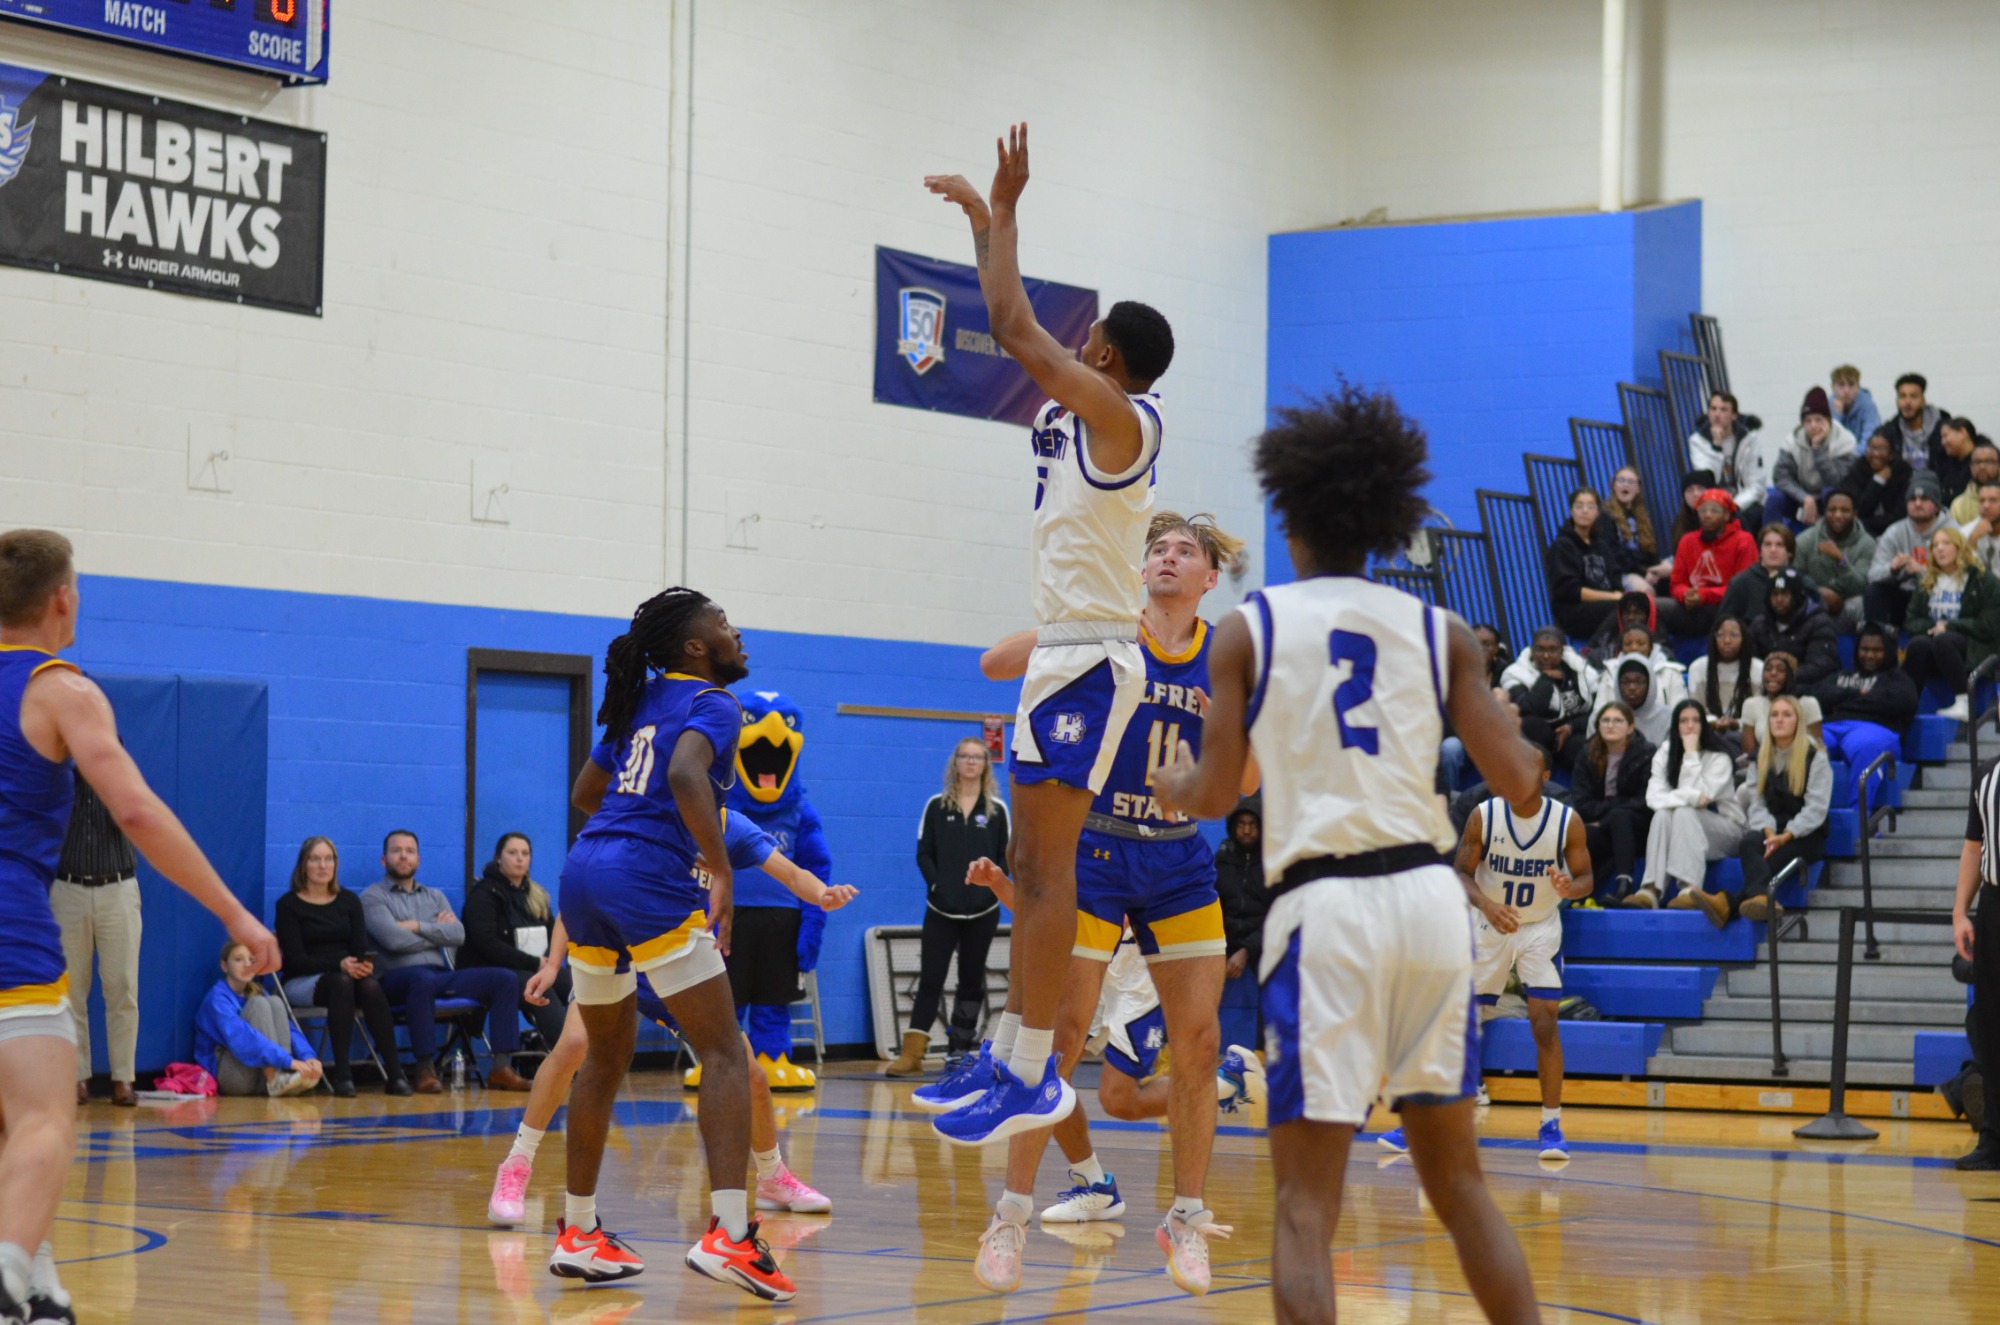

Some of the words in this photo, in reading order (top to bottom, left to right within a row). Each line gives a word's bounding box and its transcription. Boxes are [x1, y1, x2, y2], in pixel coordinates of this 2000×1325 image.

[104, 0, 167, 35] MATCH
[248, 30, 302, 64] SCORE
[60, 99, 293, 204] HILBERT
[64, 170, 282, 270] HAWKS
[128, 254, 180, 277] UNDER
[181, 264, 241, 288] ARMOUR
[909, 308, 935, 342] 50
[1329, 628, 1380, 756] 2
[1144, 719, 1181, 787] 11
[1113, 791, 1189, 822] STA
[1488, 853, 1555, 877] HILBERT
[1502, 881, 1535, 908] 10
